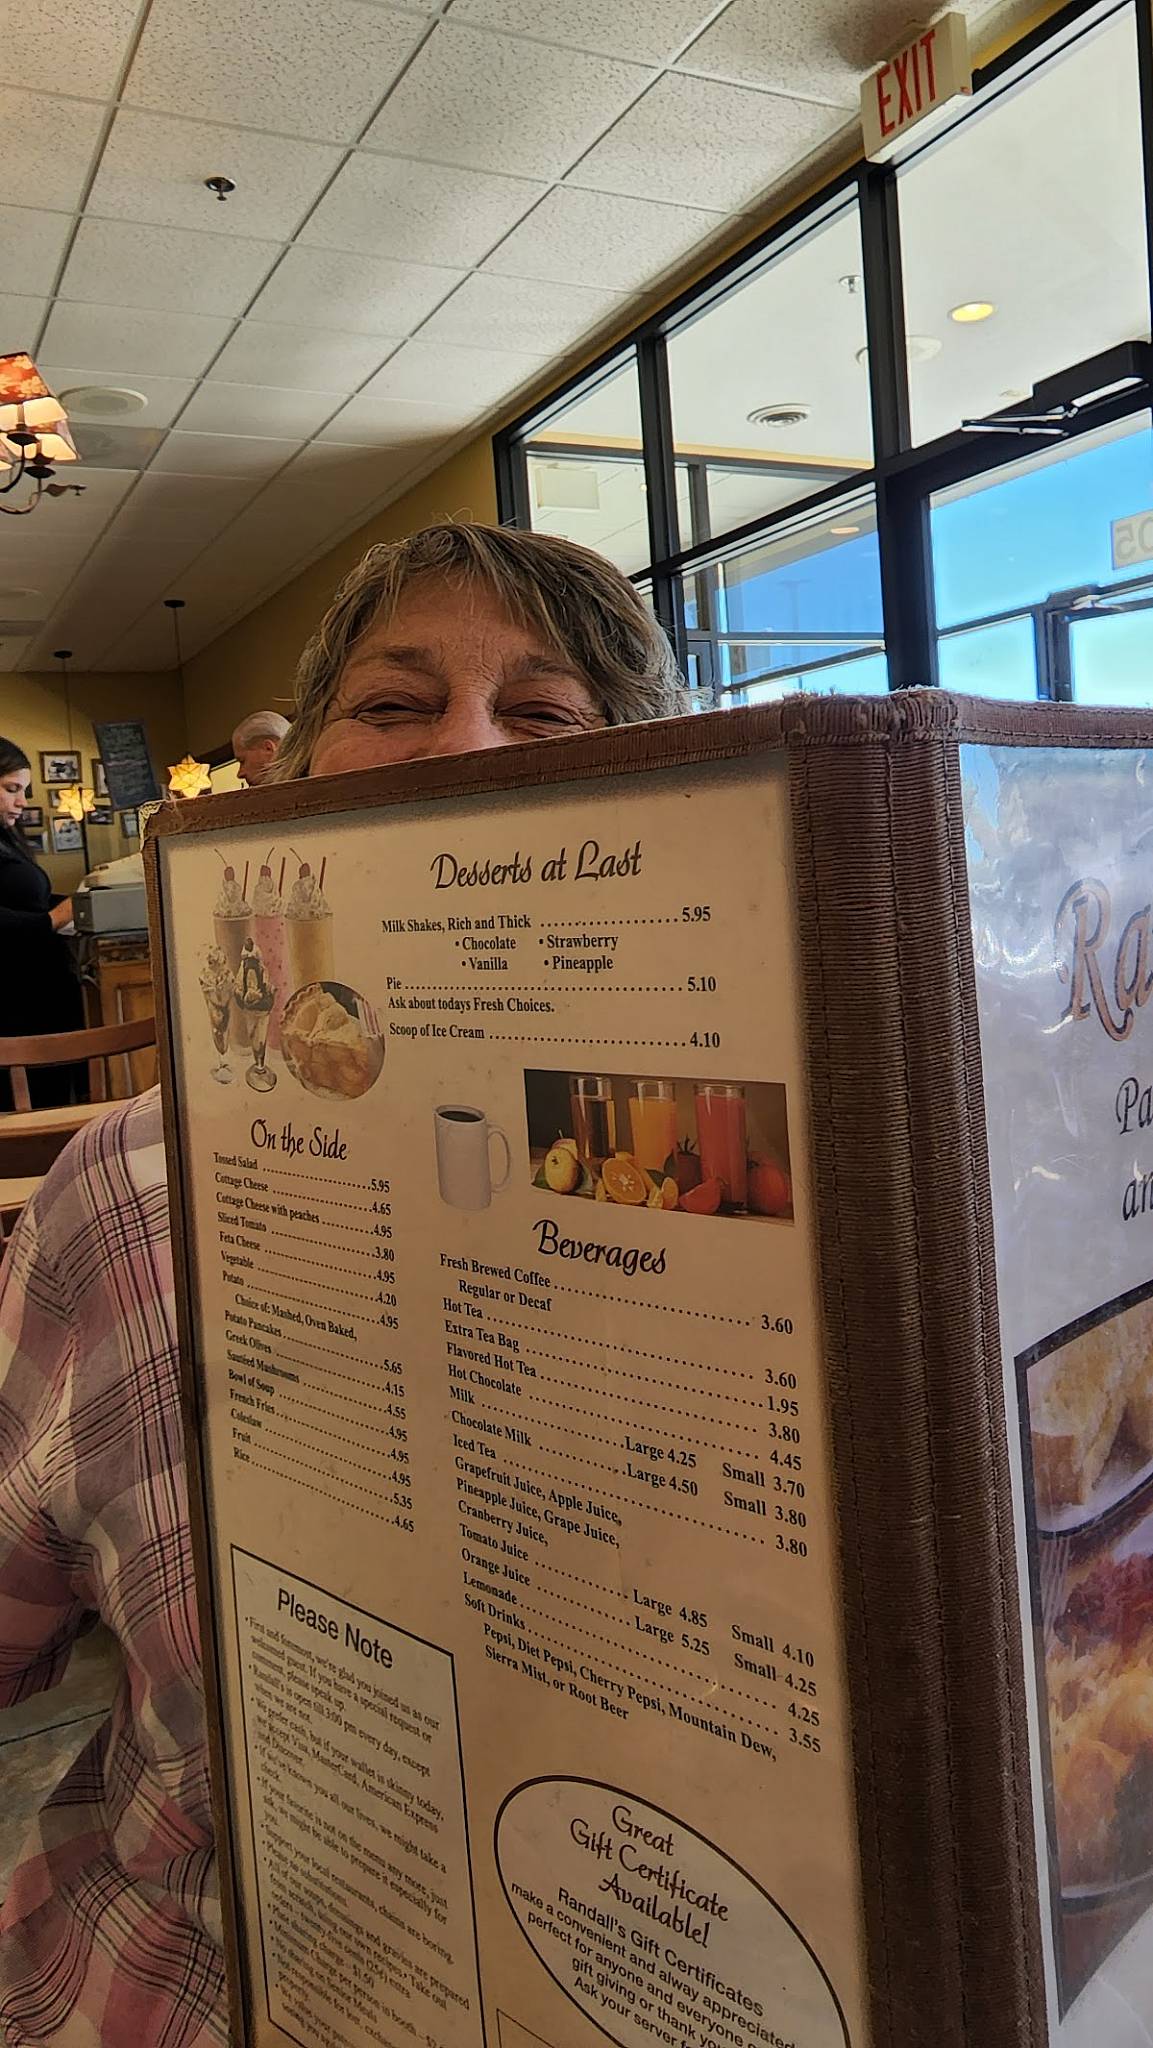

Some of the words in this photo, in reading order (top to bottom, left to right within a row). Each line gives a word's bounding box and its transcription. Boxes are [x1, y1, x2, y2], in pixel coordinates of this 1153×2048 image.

[876, 29, 936, 137] EXIT
[430, 851, 532, 889] Desserts
[541, 847, 566, 881] at
[575, 840, 641, 882] Last
[382, 920, 405, 933] Milk
[408, 919, 445, 933] Shakes,
[448, 917, 473, 930] Rich
[475, 916, 495, 930] and
[498, 915, 531, 929] Thick
[682, 906, 711, 923] 5.95
[462, 937, 516, 951] Chocolate
[547, 935, 619, 951] Strawberry
[386, 977, 402, 990] Pie
[687, 977, 716, 993] 5.10
[468, 958, 508, 971] Vanilla
[552, 956, 614, 974] Pineapple
[388, 997, 407, 1009] Ask
[408, 997, 437, 1011] about
[438, 997, 471, 1014] todays
[474, 998, 504, 1012] Fresh
[507, 998, 555, 1013] Choices.
[390, 1023, 418, 1038] Scoop
[420, 1024, 431, 1037] of
[432, 1024, 447, 1038] Ice
[450, 1025, 485, 1039] Cream
[690, 1032, 720, 1049] 4.10
[251, 1119, 276, 1150] On
[281, 1122, 304, 1158] the
[309, 1127, 347, 1160] Side
[215, 1172, 242, 1189] Cottage
[244, 1177, 269, 1192] Cheese
[372, 1201, 391, 1215] 4.65
[374, 1224, 392, 1238] 4.95
[532, 1219, 667, 1276] Beverages
[271, 1304, 303, 1325] Mashed,
[305, 1314, 326, 1331] Oven
[328, 1319, 358, 1341] Baked,
[440, 1253, 468, 1271] Fresh
[472, 1260, 511, 1280] Brewed
[514, 1269, 551, 1288] Coffee
[761, 1314, 793, 1335] 3.60
[458, 1280, 501, 1301] Regular
[504, 1292, 515, 1303] or
[518, 1293, 552, 1312] Decaf
[443, 1298, 462, 1314] Hot
[464, 1303, 483, 1319] Tea
[764, 1369, 796, 1389] 3.60
[445, 1320, 473, 1339] Extra
[476, 1327, 495, 1344] Tea
[498, 1332, 520, 1353] Bag
[767, 1396, 799, 1417] 1.95
[446, 1342, 491, 1365] Flavored
[494, 1354, 514, 1373] Hot
[516, 1360, 537, 1378] Tea
[768, 1422, 800, 1444] 3.80
[448, 1364, 467, 1381] Hot
[469, 1369, 522, 1397] Chocolate
[770, 1450, 802, 1471] 4.45
[449, 1385, 476, 1405] Milk
[625, 1435, 664, 1462] Large
[667, 1447, 696, 1469] 4.25
[722, 1462, 766, 1488] Small
[774, 1476, 805, 1499] 3.70
[451, 1409, 503, 1438] Chocolate
[505, 1425, 532, 1448] Milk
[627, 1463, 666, 1490] Large
[669, 1475, 698, 1497] 4.50
[723, 1490, 767, 1517] Small
[775, 1505, 807, 1528] 3.80
[453, 1434, 474, 1454] Iced
[476, 1442, 497, 1460] Tea
[775, 1534, 808, 1558] 3.80
[455, 1456, 512, 1487] Grapefruit
[513, 1475, 546, 1501] Juice,
[548, 1485, 583, 1512] Apple
[586, 1498, 623, 1527] Juice,
[457, 1477, 509, 1512] Pineapple
[511, 1494, 541, 1521] Juice,
[544, 1509, 580, 1536] Grape
[583, 1523, 620, 1549] Juice,
[458, 1500, 513, 1532] Cranberry
[515, 1520, 548, 1547] Juice,
[277, 1588, 339, 1640] Please
[345, 1622, 393, 1669] Note
[459, 1523, 498, 1549] Tomato
[500, 1539, 529, 1561] Juice
[633, 1589, 672, 1616] Large
[679, 1605, 707, 1628] 4.85
[731, 1624, 774, 1653] Small
[782, 1643, 814, 1668] 4.10
[461, 1548, 499, 1574] Orange
[502, 1564, 531, 1587] Juice
[635, 1615, 674, 1644] Large
[681, 1633, 710, 1656] 5.25
[734, 1653, 777, 1681] Small
[785, 1672, 817, 1697] 4.25
[463, 1571, 518, 1605] Lemonade
[787, 1702, 820, 1727] 4.25
[464, 1593, 485, 1613] Soft
[487, 1602, 526, 1631] Drinks
[789, 1728, 821, 1753] 3.55
[485, 1644, 519, 1670] Sierra
[521, 1661, 550, 1688] Mist,
[553, 1676, 566, 1690] or
[569, 1682, 597, 1706] Root
[600, 1696, 629, 1721] Beer
[484, 1623, 516, 1652] Pepsi,
[518, 1636, 541, 1659] Diet
[543, 1646, 577, 1675] Pepsi,
[579, 1666, 624, 1697] Cherry
[627, 1685, 666, 1716] Pepsi,
[668, 1702, 736, 1742] Mountain
[740, 1733, 777, 1762] Dew,
[612, 1805, 675, 1857] Great
[570, 1818, 612, 1860] Gift
[619, 1843, 730, 1922] Certificate
[511, 1882, 544, 1909] make
[546, 1904, 555, 1917] a
[556, 1909, 627, 1956] convenient
[629, 1949, 656, 1975] and
[659, 1970, 699, 2002] alway
[598, 1873, 711, 1949] Available!
[528, 1911, 573, 1948] perfect
[574, 1936, 594, 1959] for
[595, 1953, 644, 1990] anyone
[646, 1979, 674, 2006] and
[676, 2001, 743, 2047] everyone
[558, 1887, 627, 1939] Randall's
[630, 1930, 660, 1959] Gift
[664, 1948, 765, 2017] Certificates
[571, 1956, 595, 1980] gift
[596, 1971, 636, 2005] giving
[639, 1997, 656, 2013] or
[656, 2005, 696, 2041] thank
[573, 1976, 599, 2000] Ask
[600, 1993, 631, 2019] your
[633, 2012, 677, 2046] server
